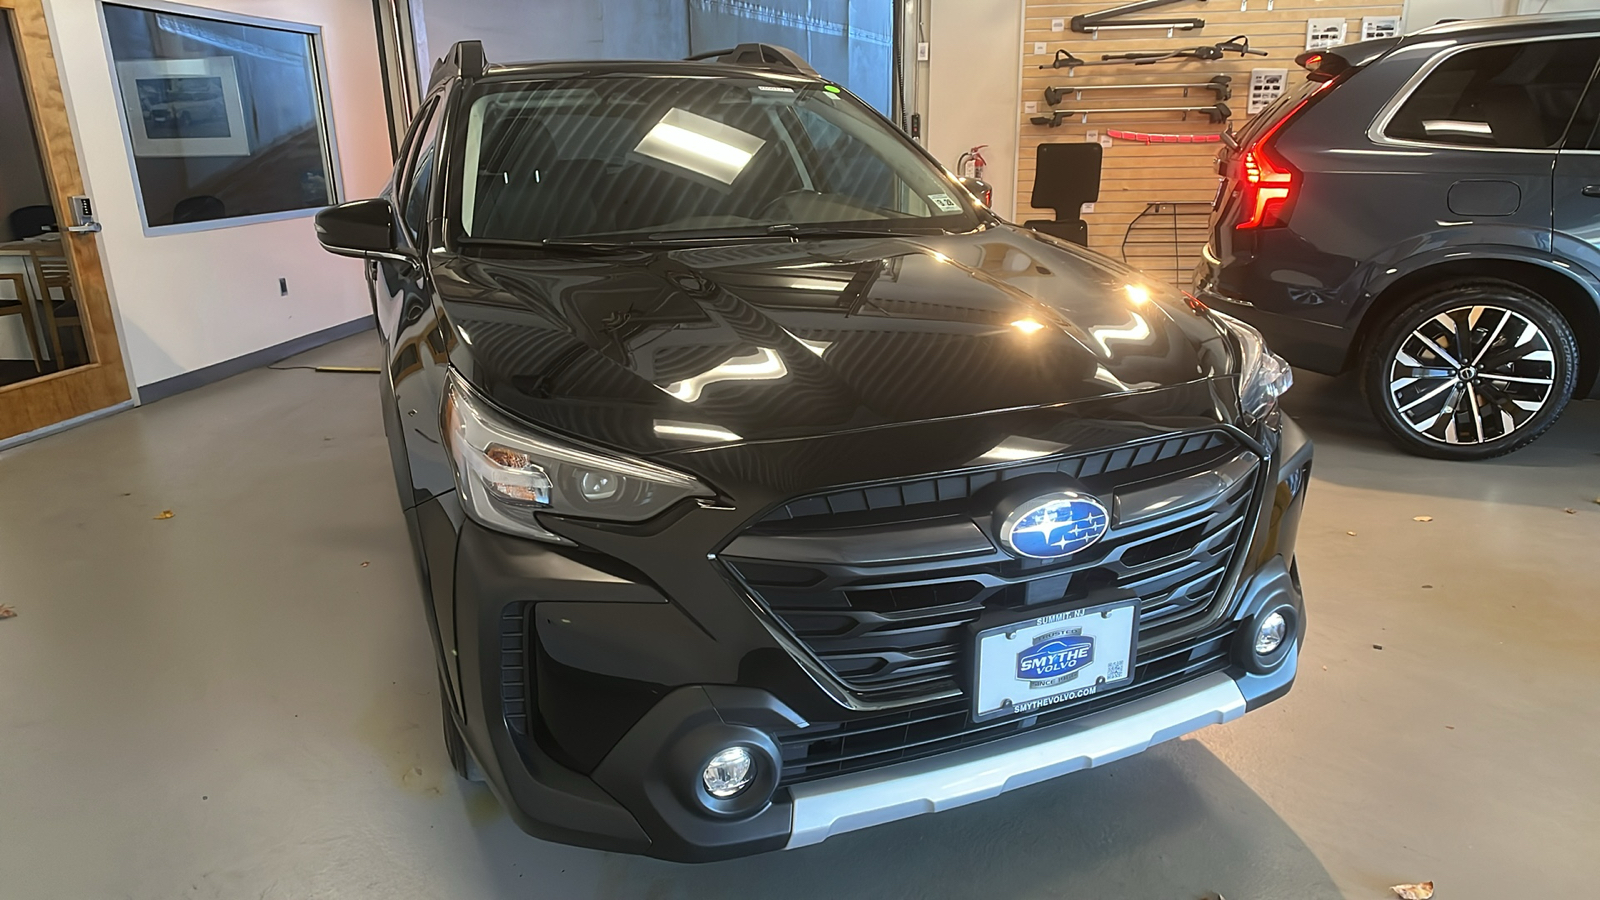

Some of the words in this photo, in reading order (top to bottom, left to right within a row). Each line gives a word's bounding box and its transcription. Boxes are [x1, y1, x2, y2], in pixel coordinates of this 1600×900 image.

[1021, 647, 1090, 671] SMYTHE
[1036, 659, 1077, 675] VOLVO
[1014, 685, 1097, 713] SMYTHEVOLVO.COM
